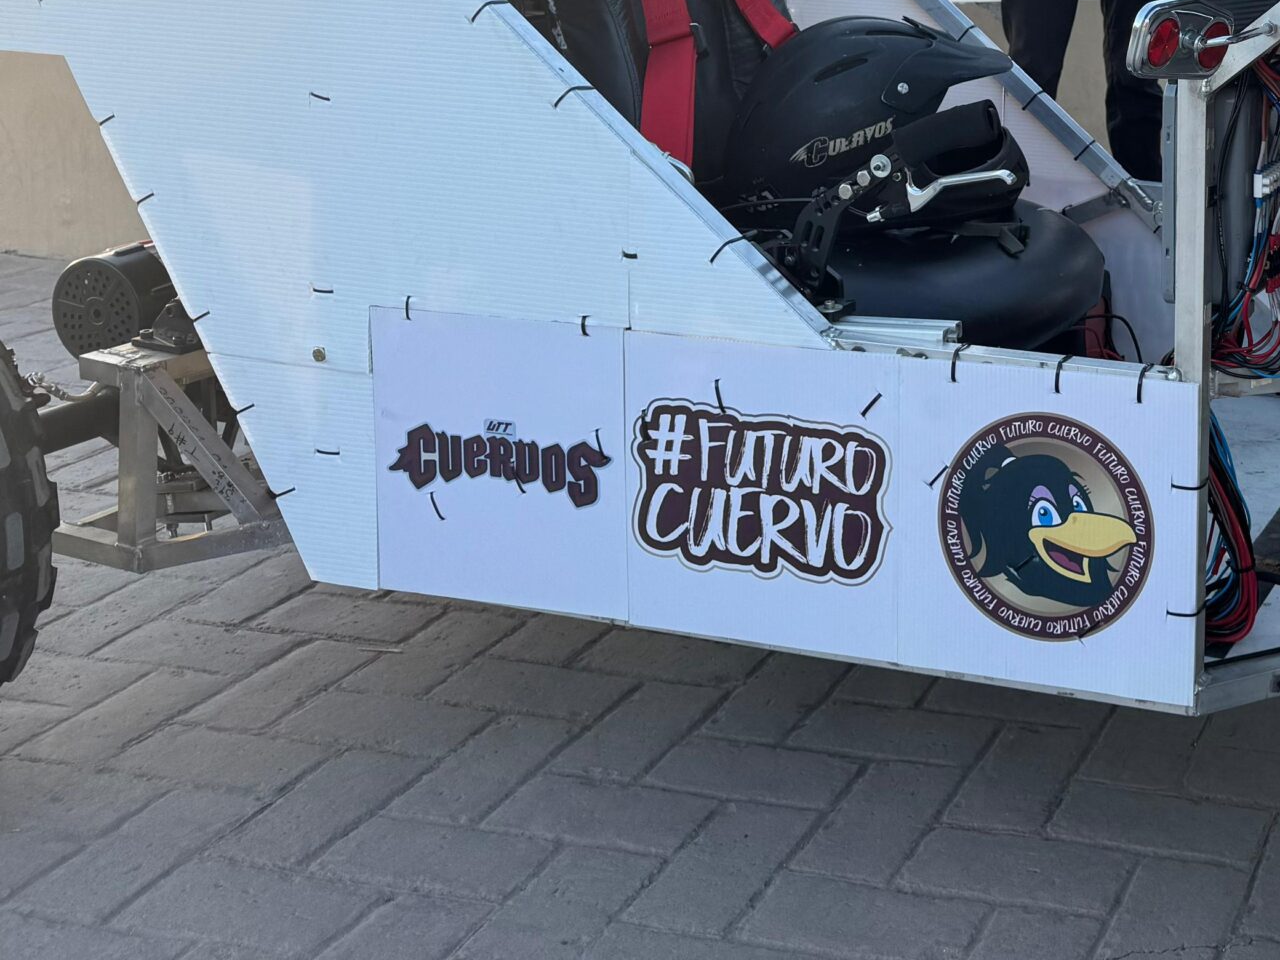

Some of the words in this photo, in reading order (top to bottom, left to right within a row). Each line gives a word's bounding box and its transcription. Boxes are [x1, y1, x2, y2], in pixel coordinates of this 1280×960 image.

[486, 420, 512, 433] UTT
[999, 419, 1044, 441] FUTURO
[1047, 421, 1093, 447] CUERVO
[645, 414, 877, 496] #FUTURO
[963, 433, 997, 471] CUERVO
[1092, 442, 1131, 484] FUTURO
[945, 468, 966, 515] FUTURO
[1125, 487, 1146, 535] CUERVO
[646, 483, 872, 571] CUERVO
[946, 519, 967, 566] CUERVO
[1125, 541, 1147, 587] FUTURO
[961, 569, 998, 611] FUTURO
[1093, 585, 1129, 622] CUERVO
[998, 606, 1042, 632] CUERVO
[1046, 613, 1092, 635] FUTURO
